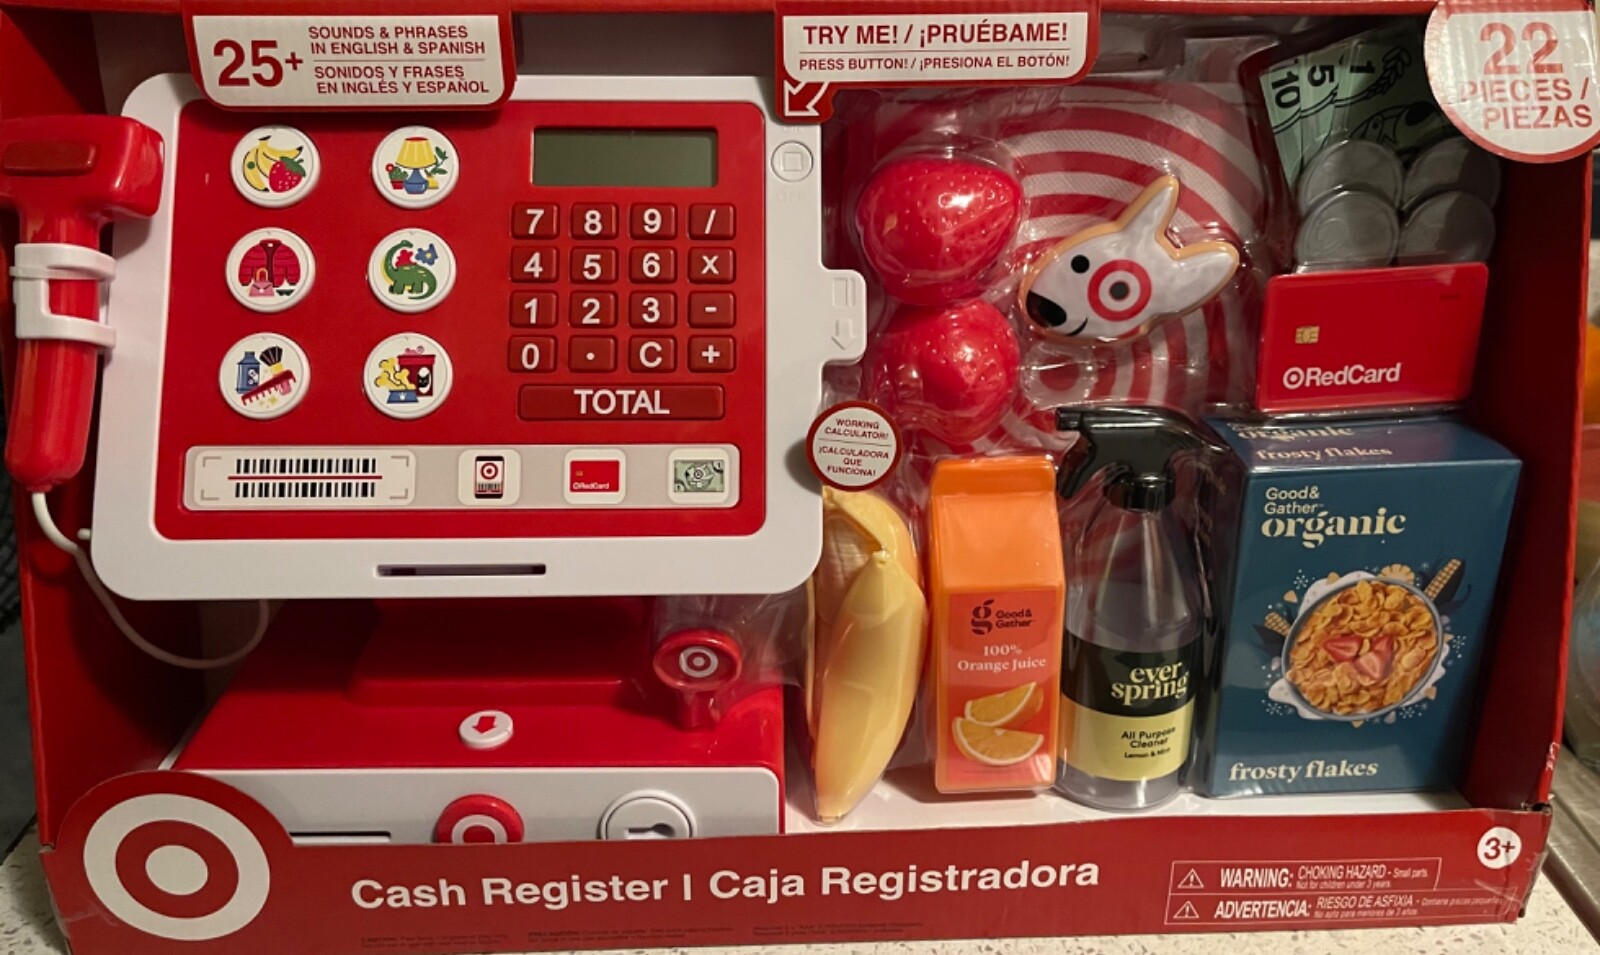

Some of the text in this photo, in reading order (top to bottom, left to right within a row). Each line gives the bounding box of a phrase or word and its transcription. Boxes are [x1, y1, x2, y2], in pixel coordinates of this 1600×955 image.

[308, 25, 468, 39] SOUNDS & PHRASES
[803, 18, 1068, 49] TRY ME! / ¡PRUÉBAME!
[311, 41, 485, 55] IN ENGLISH & SPANISH
[1479, 22, 1564, 75] 22
[213, 39, 303, 87] 25+
[314, 66, 465, 79] SONIDOS Y FRASES
[799, 53, 1070, 71] PRESS BUTTON! / ¡PRESIONA EL BOTÓN!
[1350, 61, 1376, 76] 1
[317, 77, 489, 95] EN INGLÉS Y ESPAÑOL
[1306, 63, 1335, 88] 5
[1270, 70, 1301, 109] 10
[1460, 77, 1590, 102] PIECES /
[1483, 104, 1593, 130] PIEZAS
[526, 208, 545, 235] 7
[583, 209, 602, 235] 8
[643, 208, 662, 234] 9
[523, 252, 543, 278] 4
[582, 254, 601, 280] 5
[642, 252, 660, 278] 6
[524, 297, 539, 324] 1
[581, 298, 600, 325] 2
[642, 296, 660, 323] 3
[521, 343, 540, 370] 0
[639, 341, 662, 367] C
[701, 344, 720, 364] +
[1305, 362, 1403, 388] RedCard
[574, 389, 670, 415] TOTAL
[824, 427, 889, 440] CALCULATOR!
[836, 418, 880, 430] WORKING
[843, 457, 863, 467] QUE
[1256, 446, 1393, 460] frosty flakes
[826, 465, 876, 477] FUNCIONA!
[1265, 486, 1320, 500] Good&
[1261, 507, 1407, 549] organic
[995, 619, 1032, 629] Gather
[983, 643, 1023, 657] 100%
[957, 656, 1047, 674] Orange Juice
[1129, 662, 1182, 683] ever
[1111, 671, 1189, 706] spring
[1121, 726, 1176, 740] All Purpose
[1129, 737, 1168, 749] Cleaner
[1124, 751, 1149, 759] Lemon
[1229, 759, 1379, 783] frosty flakes
[1483, 836, 1517, 861] 3+
[351, 878, 466, 909] Cash
[482, 874, 669, 910] Register
[709, 868, 805, 904] Caja
[820, 860, 1100, 901] Registradora
[1219, 867, 1294, 888] WARNING:
[1297, 865, 1344, 880] CHOKING
[1345, 864, 1387, 880] HAZARD
[1393, 867, 1411, 879] Small
[1214, 900, 1312, 919] ADVERTENCIA:
[1315, 895, 1357, 909] RIESGO
[1357, 895, 1374, 908] DE
[1374, 894, 1413, 907] ASFIXIA
